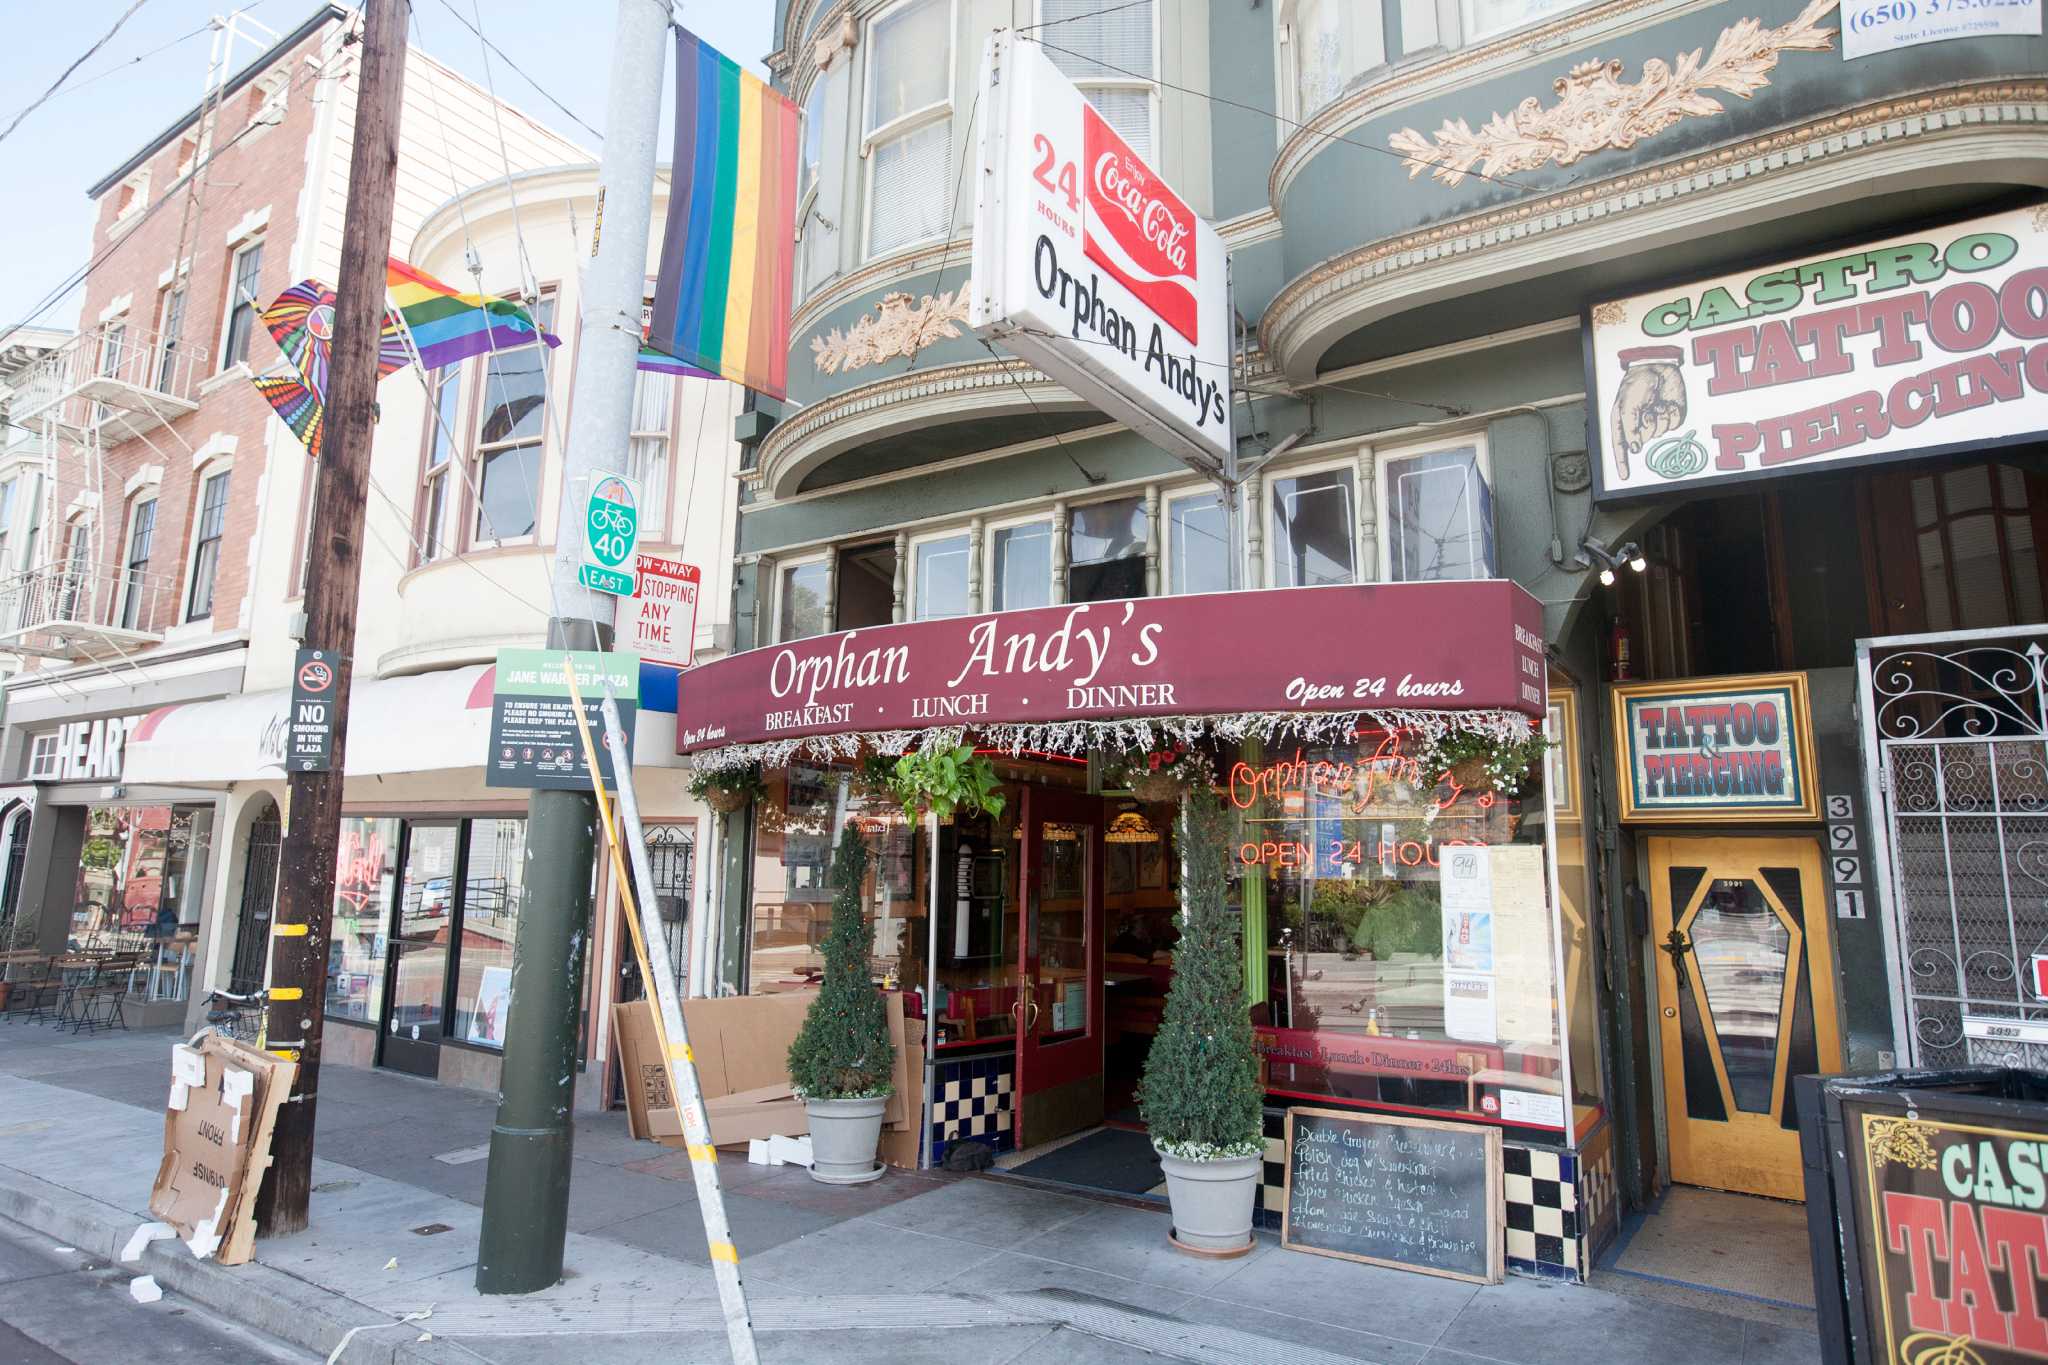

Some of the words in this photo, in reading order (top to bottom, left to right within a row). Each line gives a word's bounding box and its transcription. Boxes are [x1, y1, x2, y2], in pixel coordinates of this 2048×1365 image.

[1850, 3, 1917, 33] (650)
[1033, 133, 1081, 213] 24
[1123, 156, 1146, 186] Enjoy
[1037, 200, 1076, 239] HOURS
[1641, 232, 2019, 338] CASTRO
[1034, 234, 1137, 361] Orphan
[1144, 322, 1225, 427] Andy's
[1692, 266, 2048, 396] TATTOO
[593, 532, 626, 561] 40
[589, 569, 624, 591] EAST
[636, 555, 694, 579] OW-AWAY
[643, 578, 695, 605] STOPPING
[640, 601, 672, 622] ANY
[637, 621, 672, 644] TIME
[770, 630, 910, 707] Orphan
[947, 602, 1164, 687] Andy's
[506, 671, 538, 685] JANE
[540, 672, 591, 687] WARER
[1285, 676, 1345, 702] Open
[1354, 678, 1386, 699] 24
[1396, 673, 1465, 698] hours
[298, 704, 326, 724] NO
[765, 703, 854, 731] BREAKFAST
[911, 693, 990, 719] LUNCH
[1066, 683, 1178, 711] DINNER
[292, 724, 329, 734] SMOKING
[297, 734, 306, 743] IN
[307, 734, 323, 743] THE
[1639, 701, 1780, 749] TATTOO
[296, 744, 322, 753] PLAZA
[1231, 746, 1354, 810] Orphan
[1643, 750, 1785, 798] PIERCING
[1240, 841, 1315, 867] OPEN
[1329, 841, 1362, 865] 24
[1377, 840, 1489, 867] HOU
[1452, 856, 1476, 876] 94
[197, 1118, 225, 1146] FRONT
[1941, 1140, 2048, 1210] CAS
[1883, 1190, 2048, 1360] TAT
